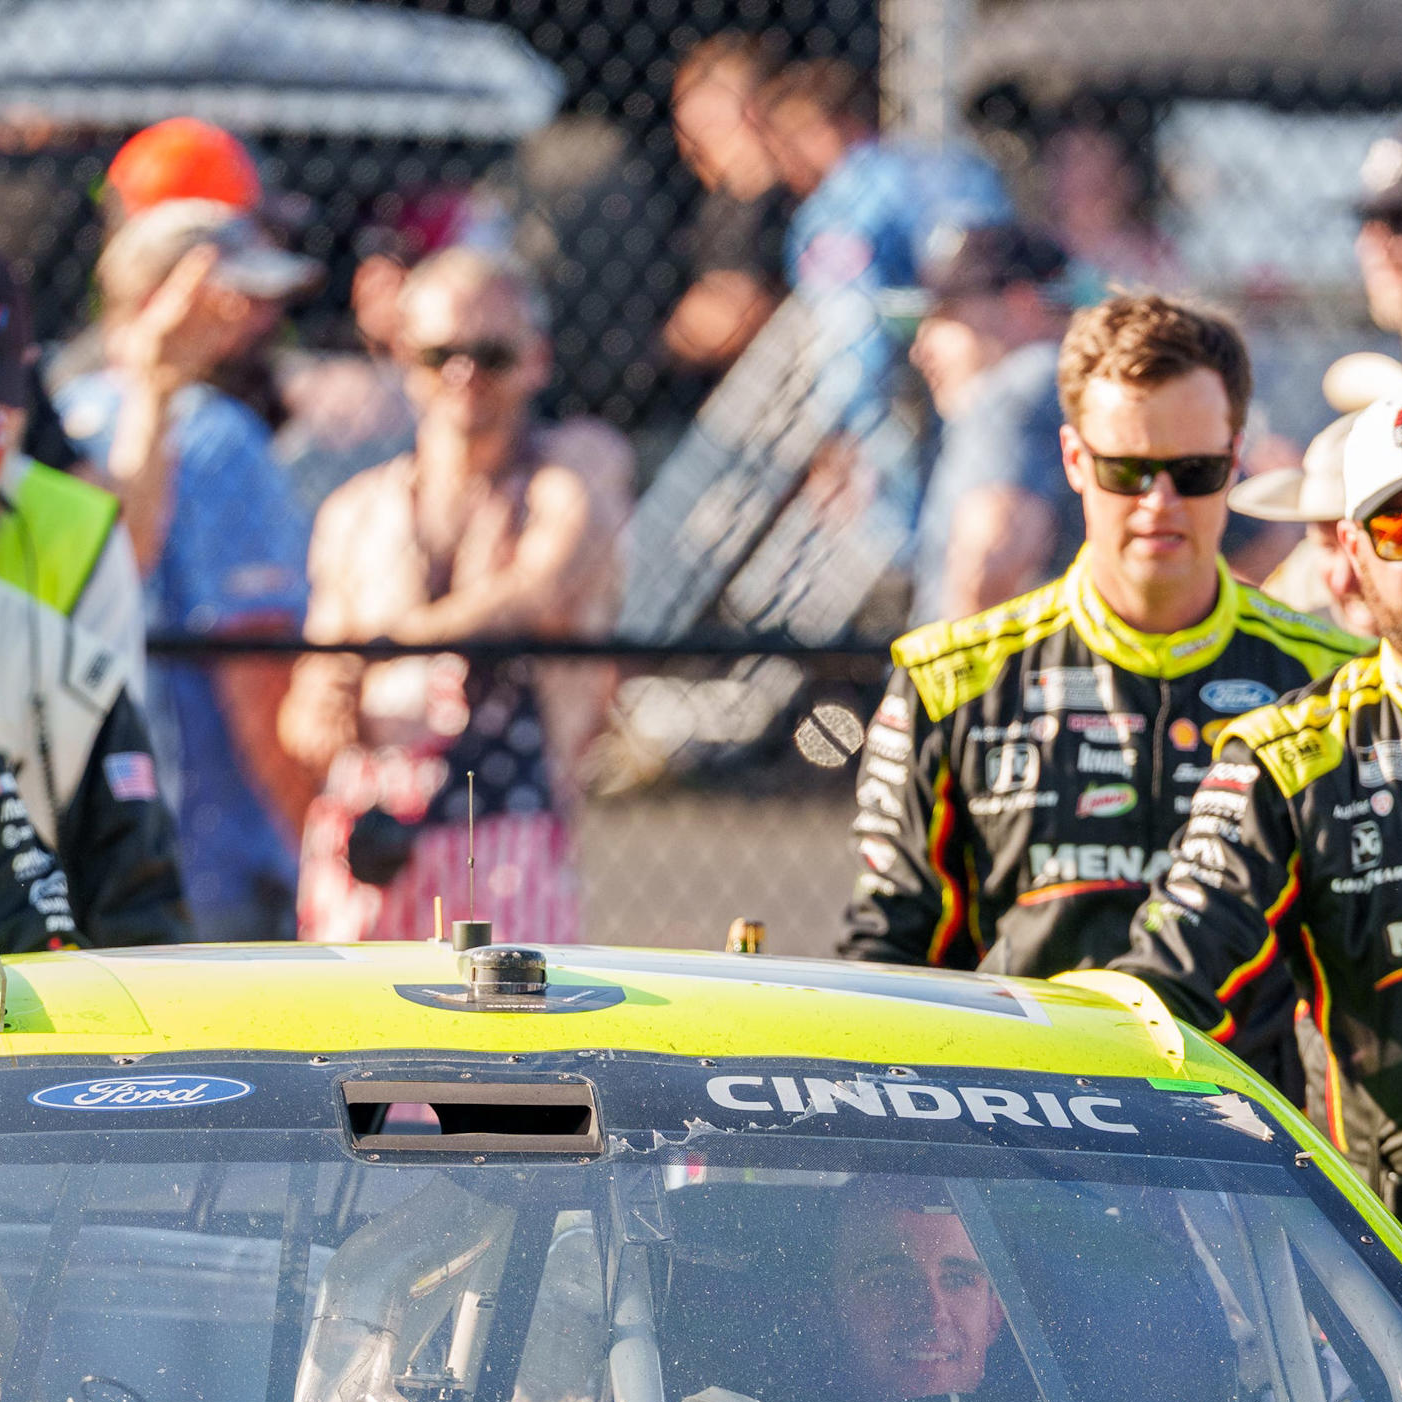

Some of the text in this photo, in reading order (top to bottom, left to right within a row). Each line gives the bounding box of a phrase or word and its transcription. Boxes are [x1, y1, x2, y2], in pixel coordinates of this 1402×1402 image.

[1028, 842, 1174, 883] MENA
[72, 1078, 209, 1107] Ford
[706, 1075, 1140, 1134] CINDRIC
